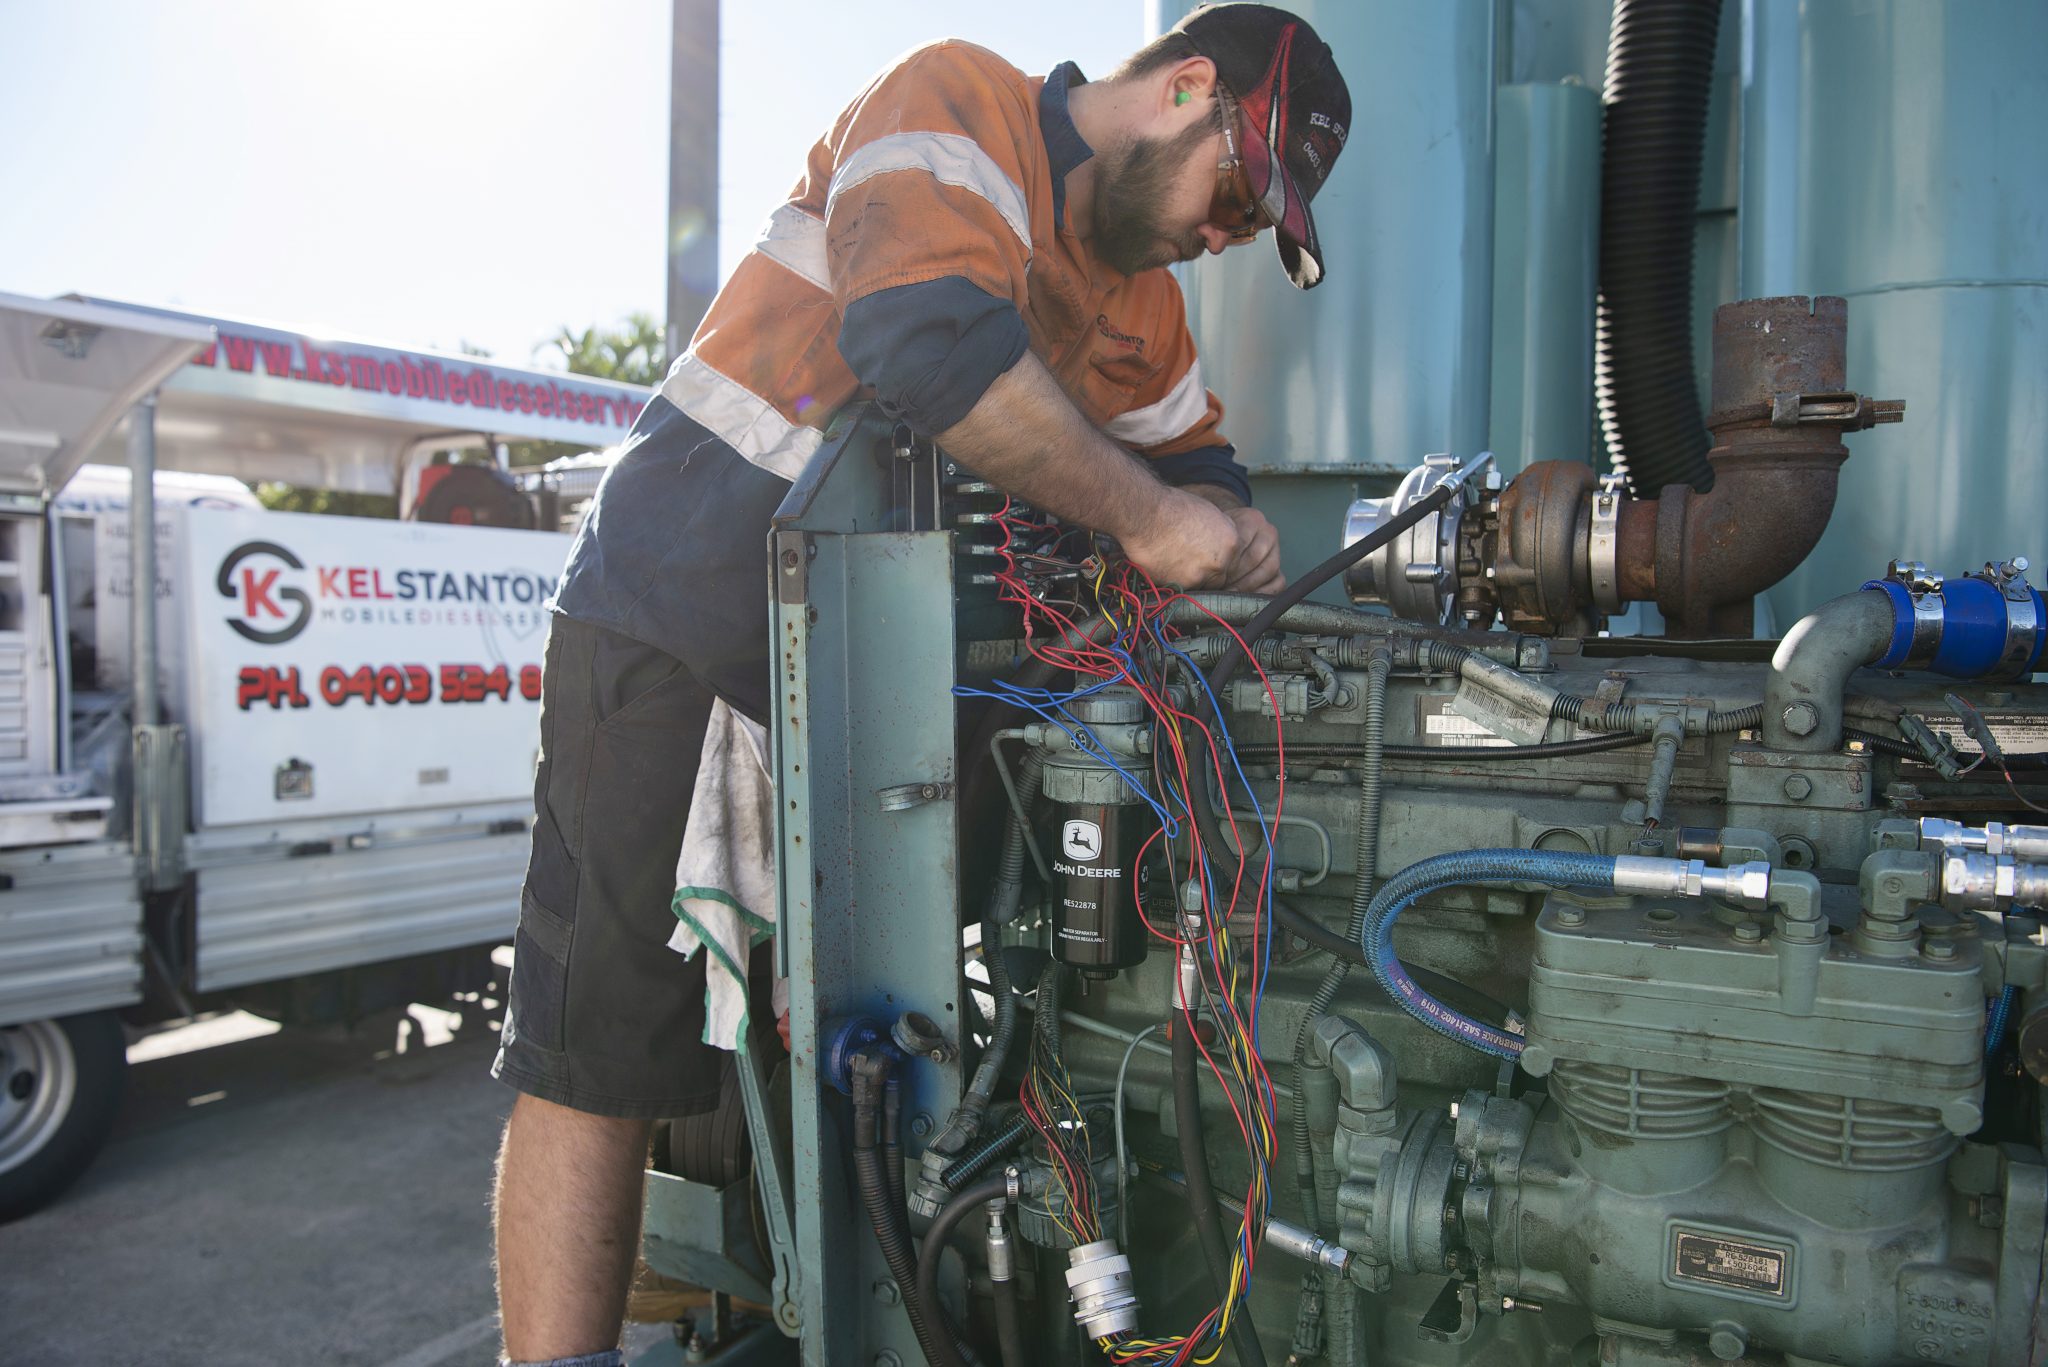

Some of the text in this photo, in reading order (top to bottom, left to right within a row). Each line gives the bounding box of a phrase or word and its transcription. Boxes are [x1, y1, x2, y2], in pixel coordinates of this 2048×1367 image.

[319, 662, 433, 707] 0403
[439, 662, 513, 705] 524
[1053, 860, 1122, 879] JOHN DEERE
[1063, 898, 1097, 911] RE522878
